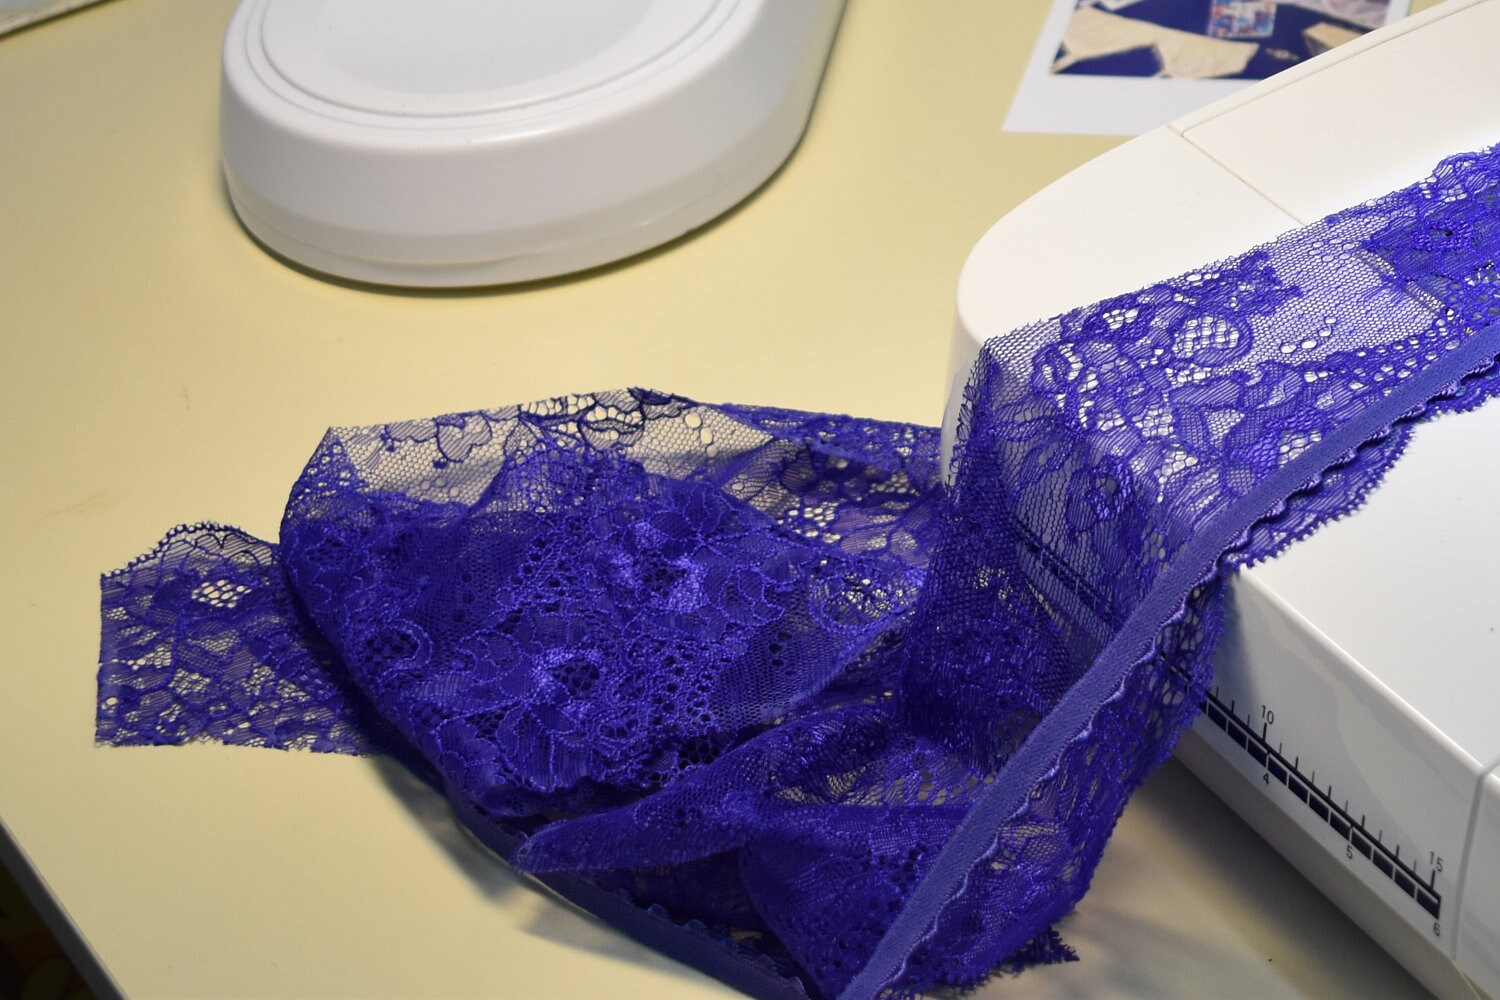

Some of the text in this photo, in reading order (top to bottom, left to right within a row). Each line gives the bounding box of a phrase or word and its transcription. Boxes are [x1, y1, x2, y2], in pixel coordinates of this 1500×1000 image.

[1261, 704, 1444, 873] 10 15
[1262, 772, 1441, 937] 4 5 6
